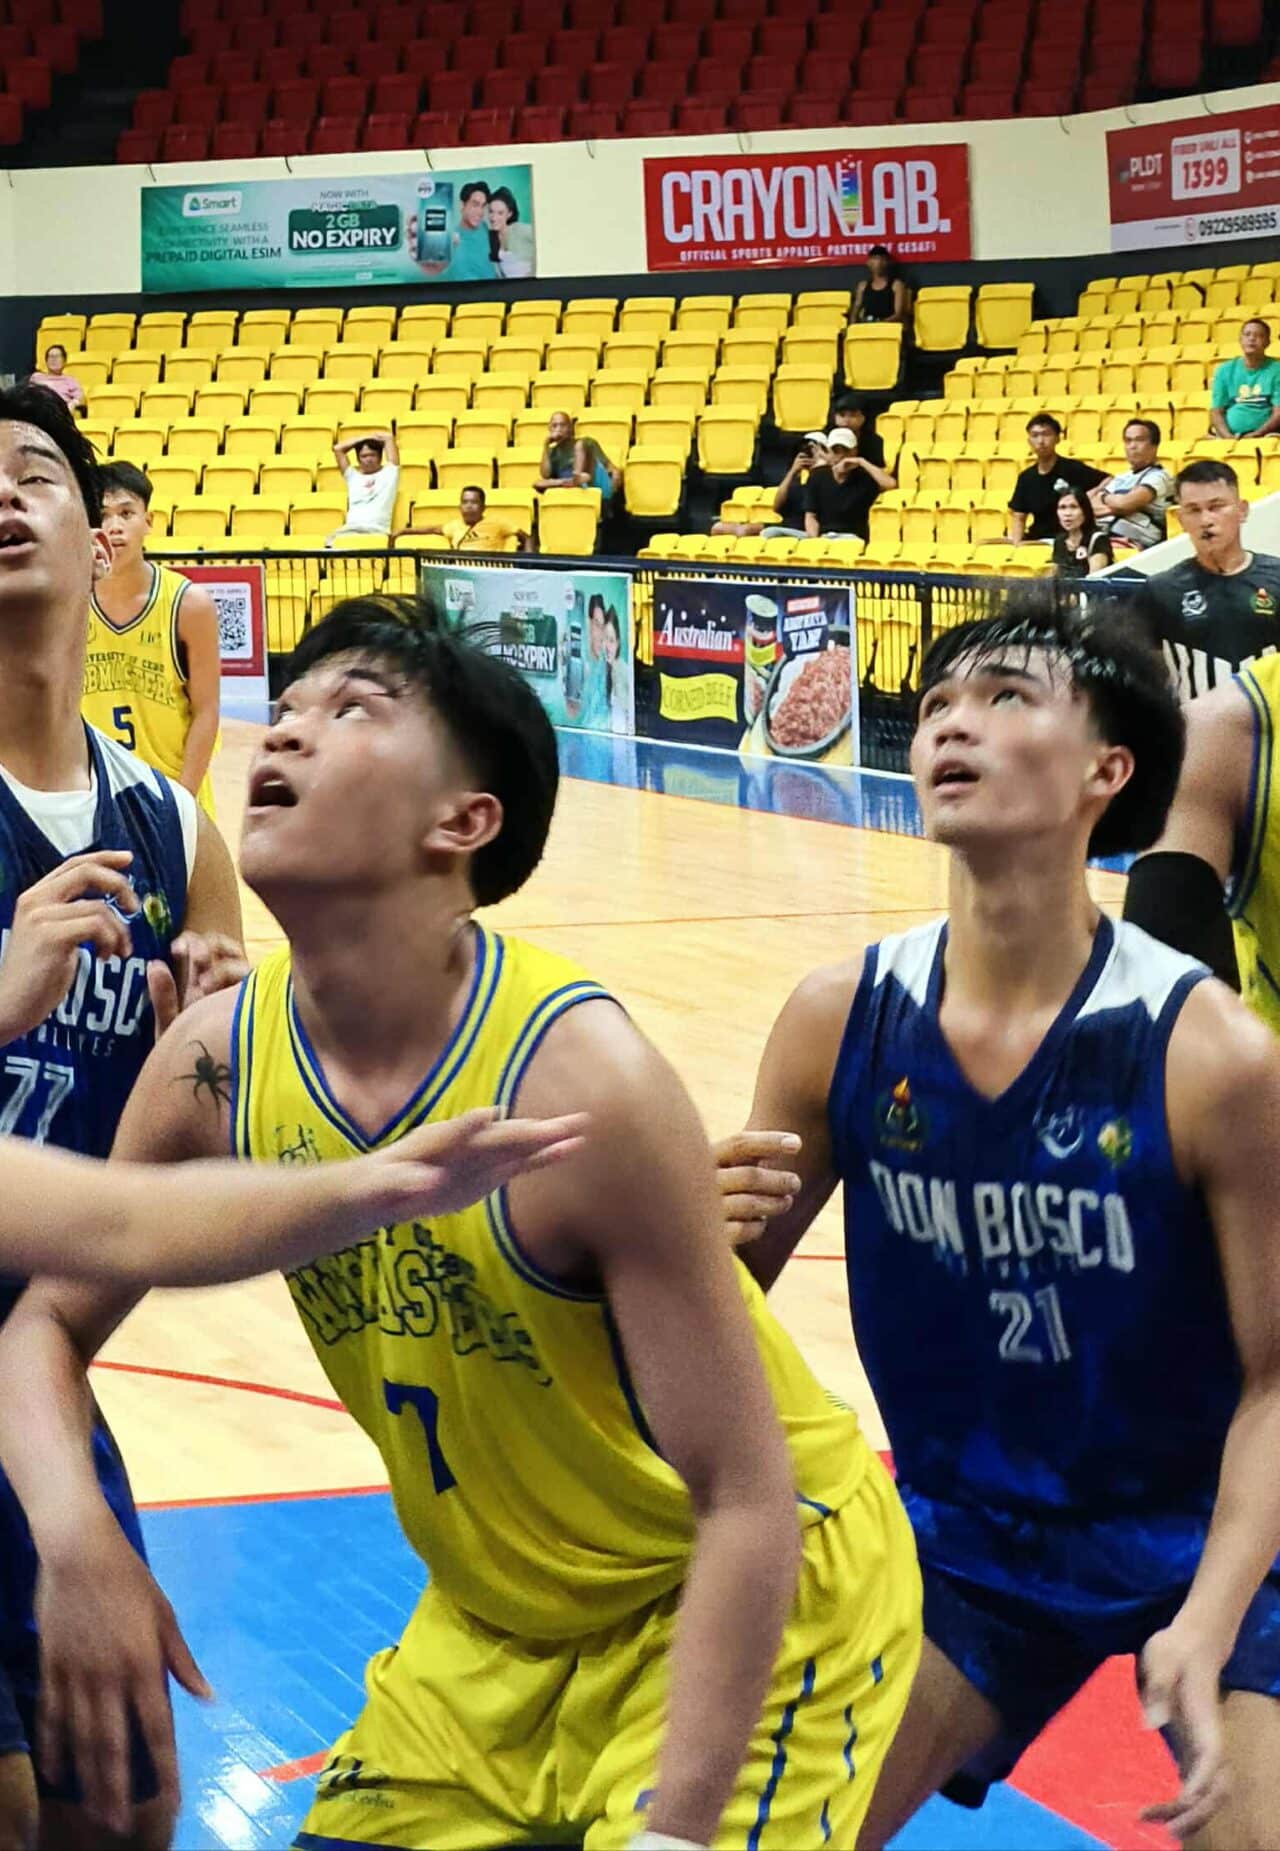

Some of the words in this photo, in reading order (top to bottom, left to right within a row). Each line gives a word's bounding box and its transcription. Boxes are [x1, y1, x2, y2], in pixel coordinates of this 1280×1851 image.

[1130, 153, 1163, 178] PLDT
[1182, 156, 1229, 190] 1399
[202, 196, 237, 209] Smart
[326, 215, 335, 228] 2
[337, 213, 360, 227] GB
[1198, 212, 1277, 237] 09229589595
[293, 230, 324, 248] NO
[326, 227, 396, 247] EXPIRY
[200, 248, 248, 261] DIGITAL
[251, 247, 282, 259] ESIM
[680, 250, 727, 262] OFFICIAL
[731, 248, 772, 260] SPORTS
[776, 246, 822, 258] APPAREL
[658, 608, 733, 650] Australian
[112, 705, 136, 751] 5
[973, 1181, 1136, 1274] BOSCO
[988, 1283, 1072, 1364] 21
[382, 1377, 459, 1496] 7
